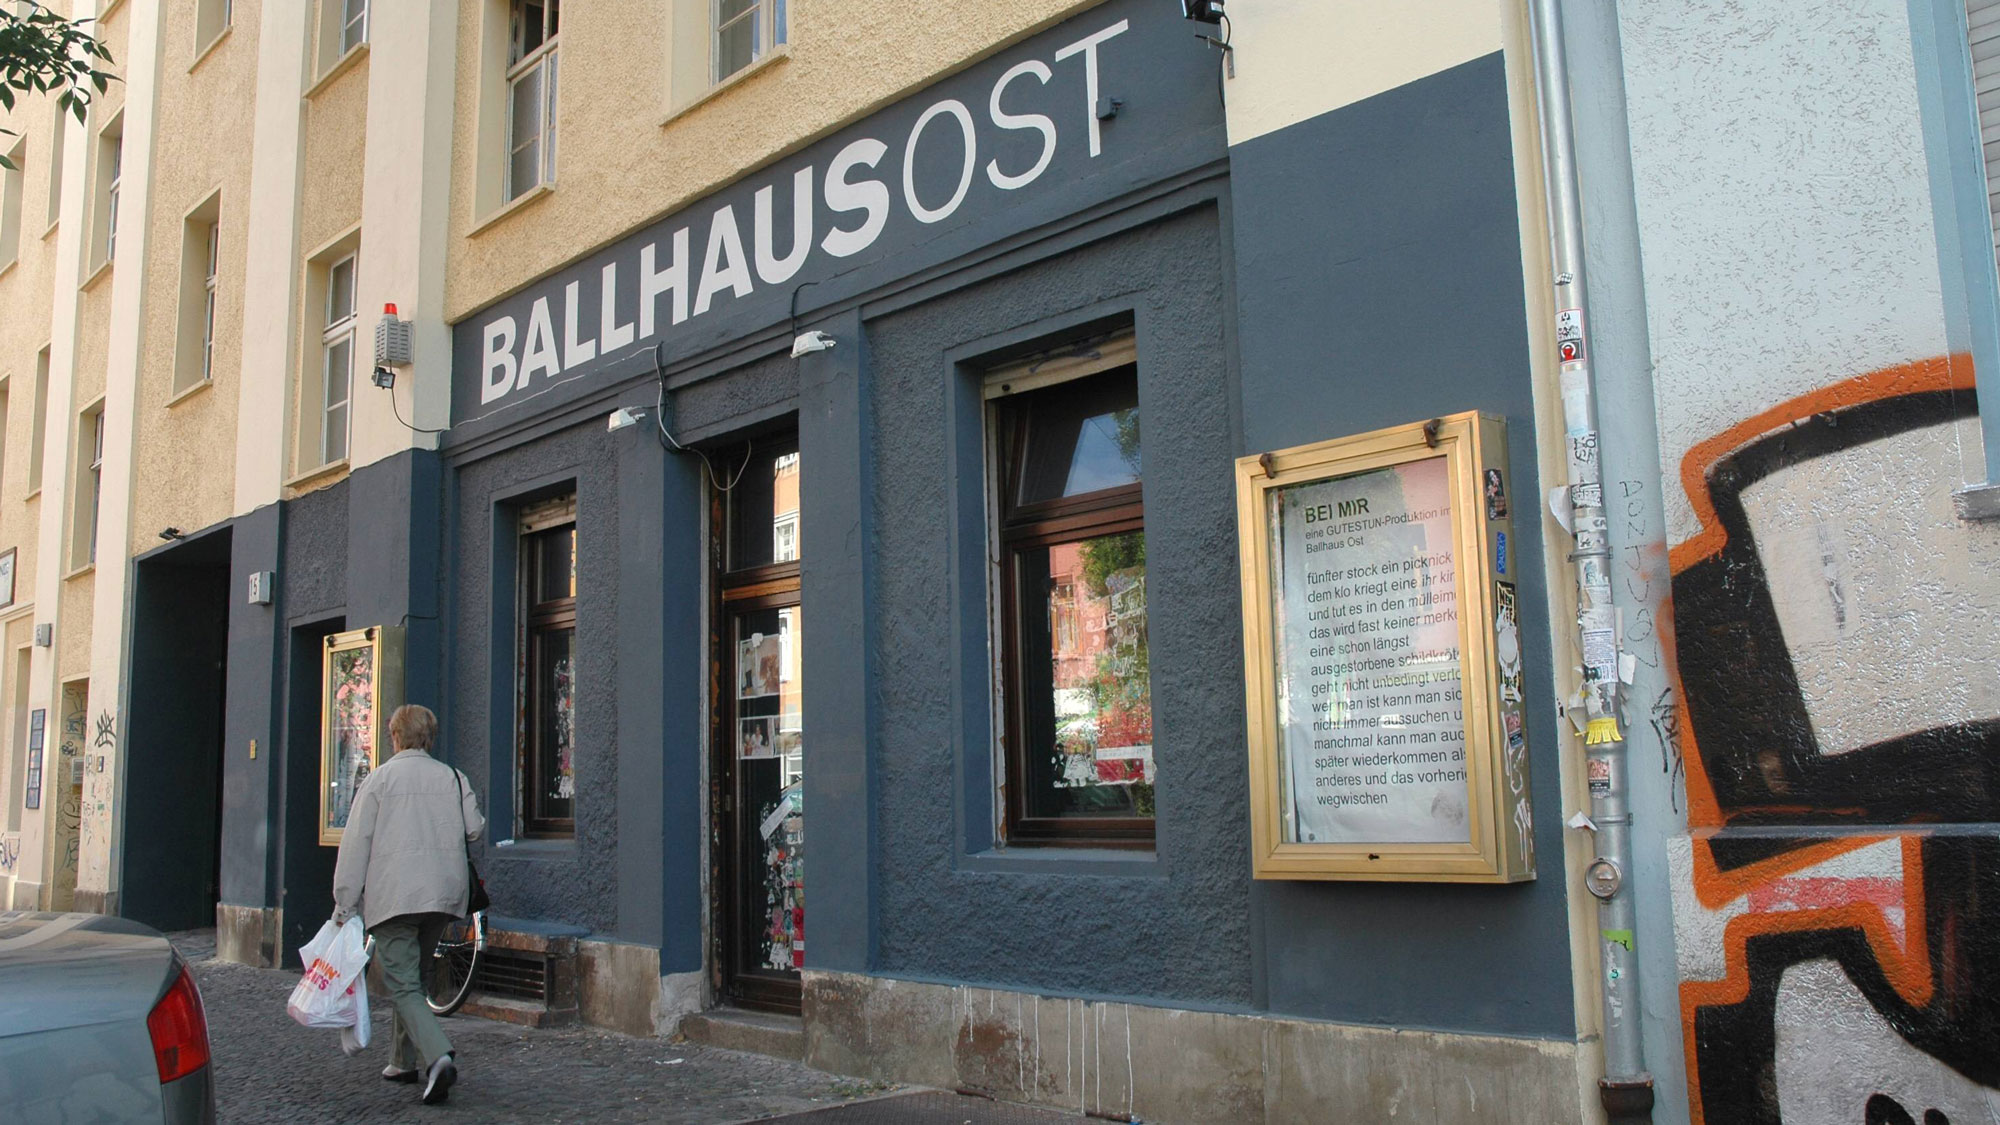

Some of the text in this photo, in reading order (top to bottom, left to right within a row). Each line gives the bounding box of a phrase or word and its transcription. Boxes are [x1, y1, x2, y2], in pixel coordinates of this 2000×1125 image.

[1305, 498, 1370, 523] BEI MIR
[1306, 528, 1323, 539] eine
[1307, 536, 1364, 553] Ballhaus Ost
[1308, 552, 1451, 584] fünfter stock ein picknick
[1308, 590, 1332, 603] dem
[1335, 585, 1350, 598] klo
[1355, 579, 1387, 597] kriegt
[1391, 577, 1417, 590] eine
[1422, 574, 1436, 586] ihr
[1309, 591, 1456, 621] und tut es in den mülleim
[1309, 627, 1330, 639] das
[1333, 622, 1355, 636] wird
[1359, 620, 1380, 632] fast
[1384, 615, 1420, 629] keiner
[1310, 635, 1409, 658] eine schon längst
[1311, 650, 1459, 677] ausgestorbene schildkröt
[1312, 683, 1338, 697] geht
[1342, 679, 1369, 692] nicht
[1373, 671, 1429, 689] unbedingt
[1312, 700, 1332, 712] wer
[1338, 699, 1362, 710] man
[1367, 695, 1380, 708] ist
[1383, 694, 1411, 707] kann
[1415, 692, 1440, 704] man
[1313, 718, 1340, 731] nicht
[1344, 717, 1380, 728] immer
[1384, 711, 1448, 726] aussuchen
[1314, 735, 1372, 749] manchmal
[1377, 733, 1405, 745] kann
[1410, 732, 1436, 743] man
[1315, 754, 1348, 769] später
[1352, 751, 1447, 766] wiederkommen
[1316, 775, 1361, 787] anderes
[1365, 772, 1387, 785] und
[1391, 771, 1413, 784] das
[1317, 792, 1387, 808] wegwischen
